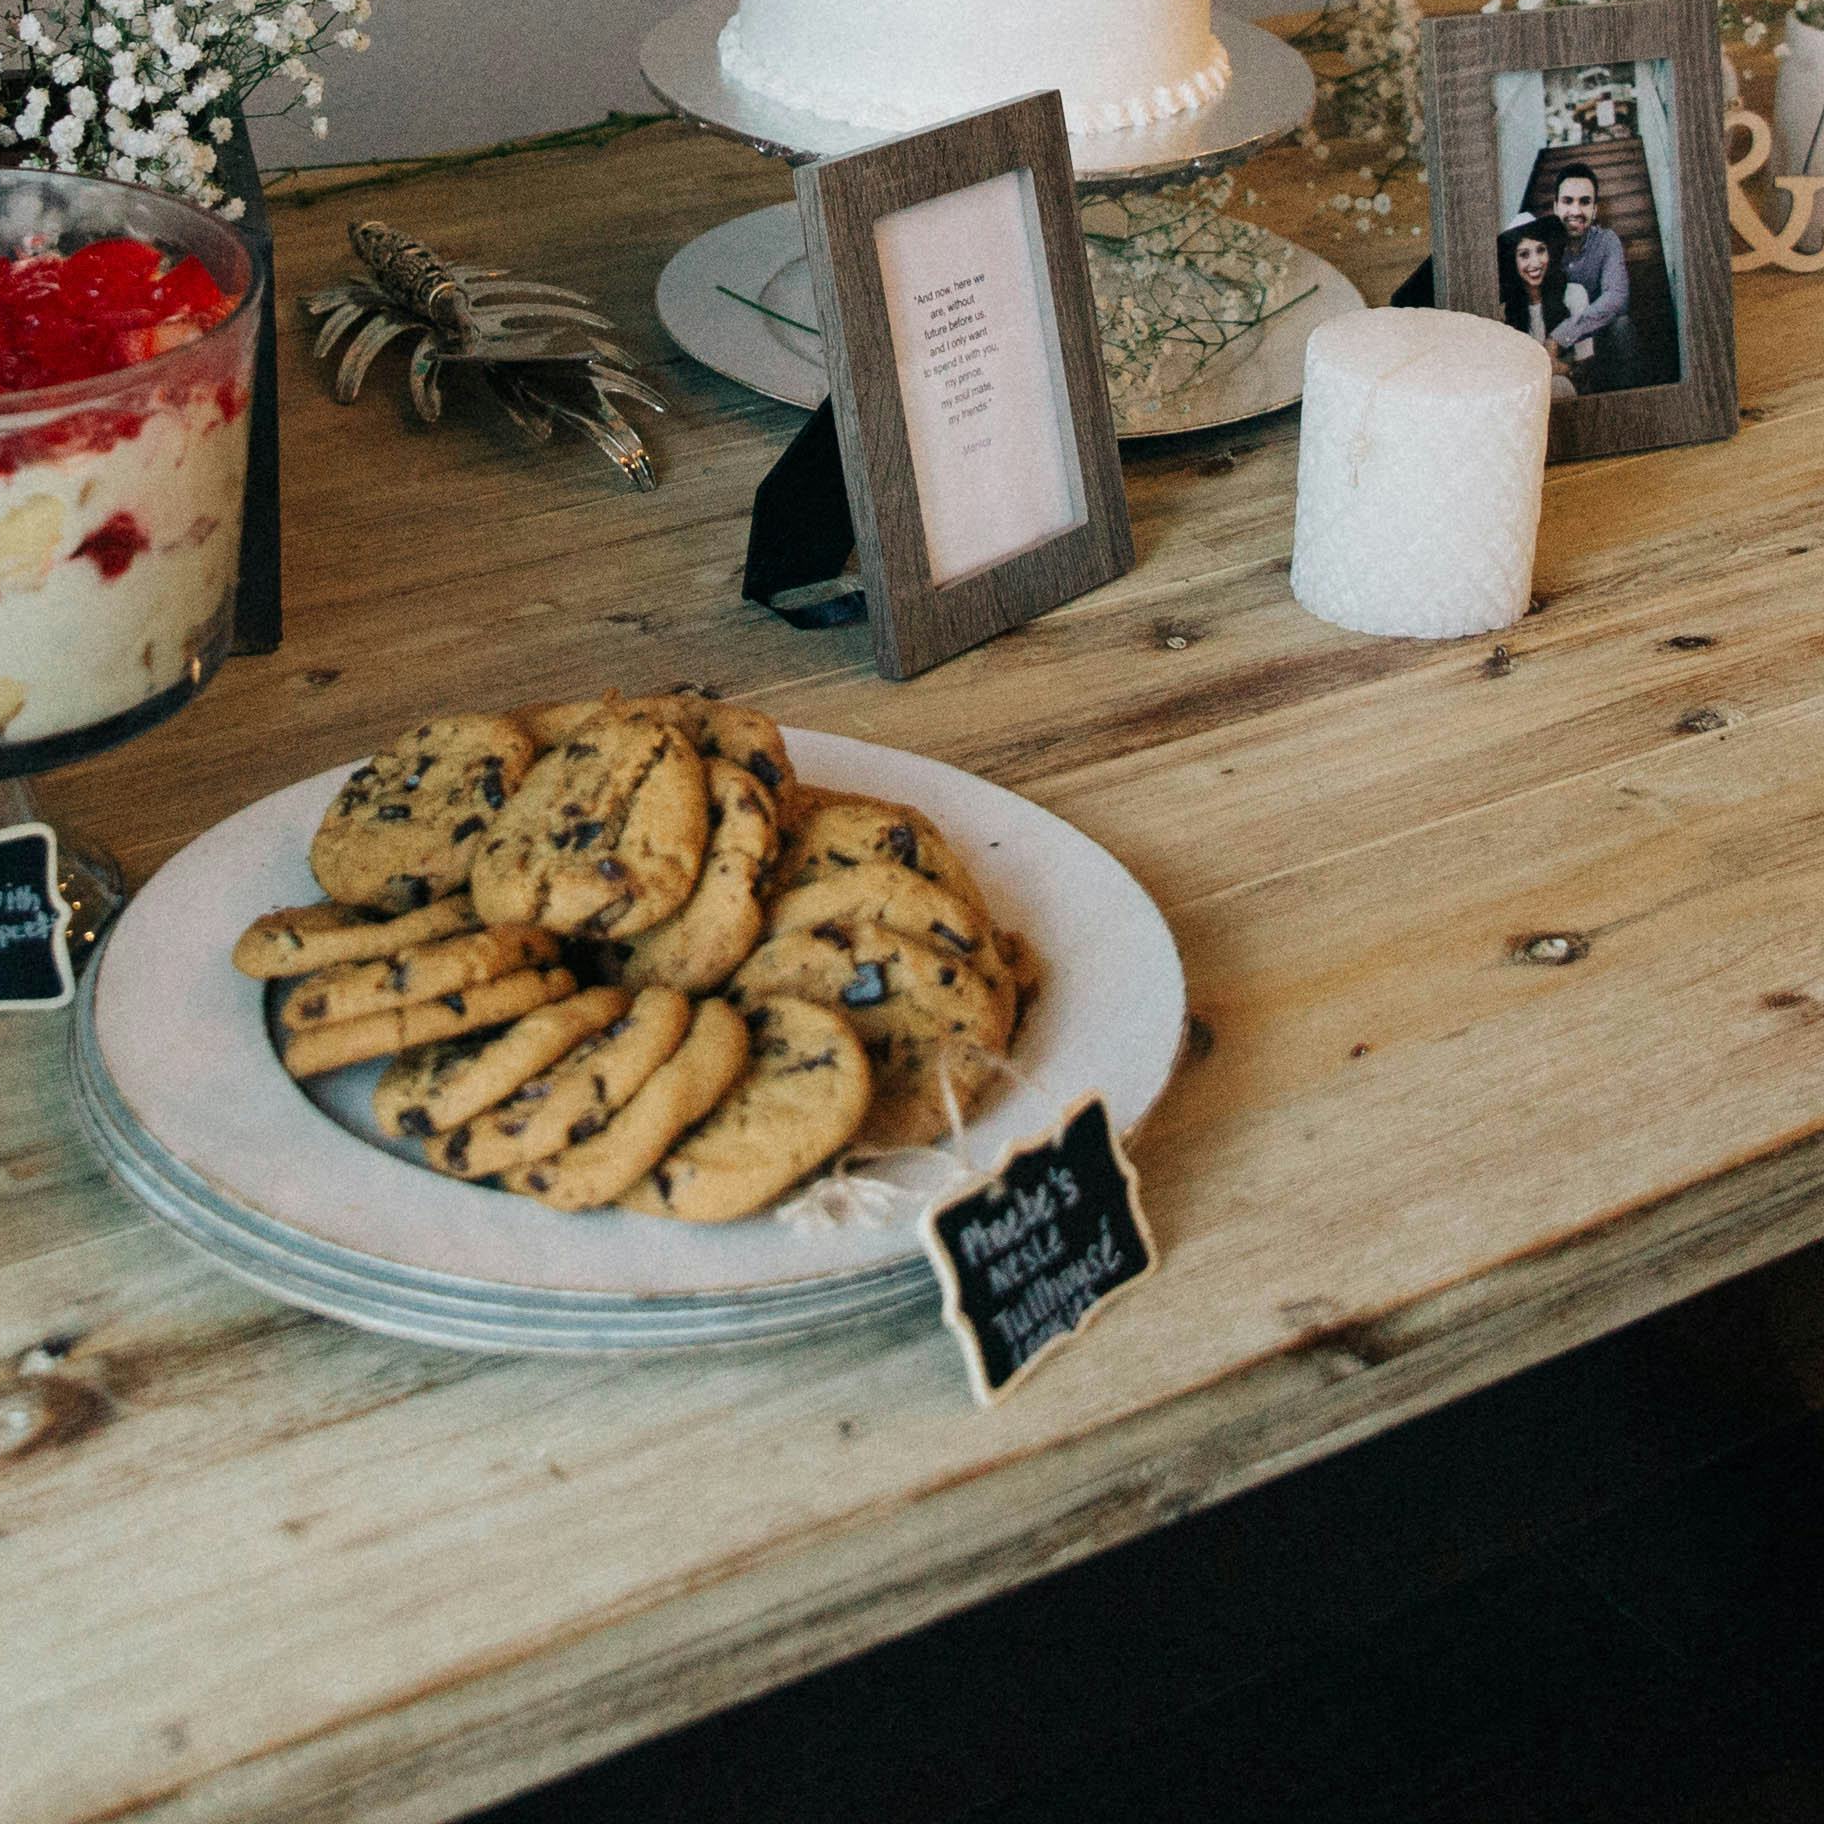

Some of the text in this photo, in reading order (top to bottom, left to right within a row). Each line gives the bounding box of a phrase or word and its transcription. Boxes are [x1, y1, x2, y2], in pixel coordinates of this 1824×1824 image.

[953, 279, 972, 291] here
[923, 325, 948, 341] future
[948, 315, 974, 332] before
[929, 342, 946, 358] and
[951, 335, 967, 349] only
[968, 326, 988, 342] want
